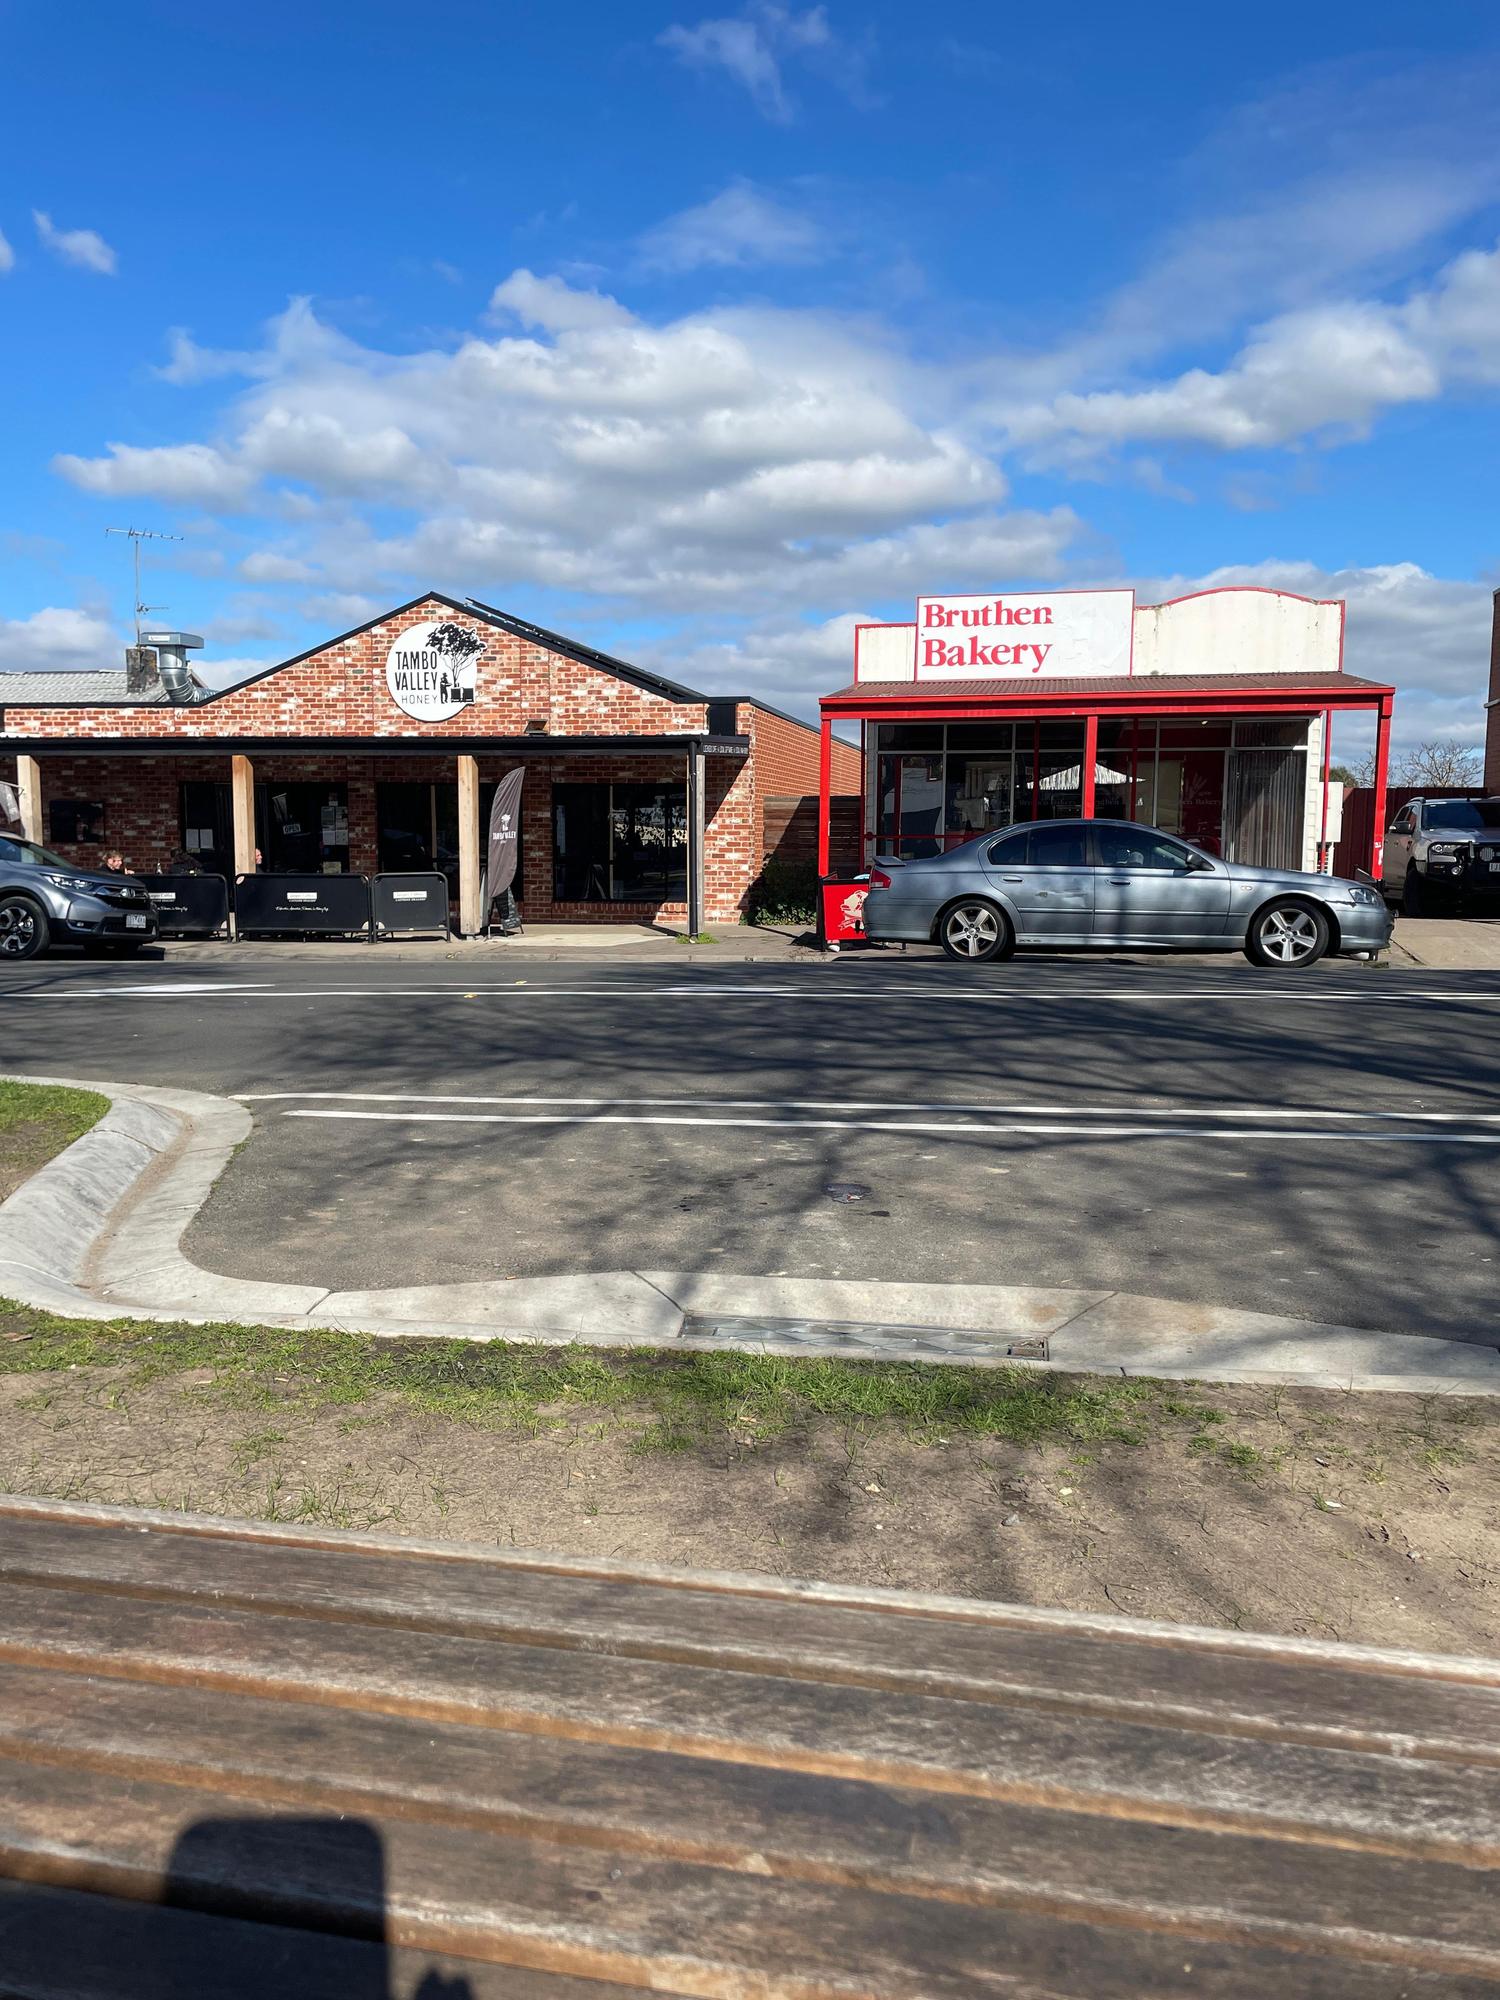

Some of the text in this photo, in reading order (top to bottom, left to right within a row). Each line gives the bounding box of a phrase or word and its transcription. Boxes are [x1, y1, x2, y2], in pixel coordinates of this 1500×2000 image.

[922, 600, 1055, 628] Bruthen
[395, 650, 438, 670] TAMBO
[922, 635, 1053, 673] Bakery
[395, 672, 438, 691] VALLEY
[401, 694, 438, 704] HONEY
[285, 825, 300, 833] OPEN
